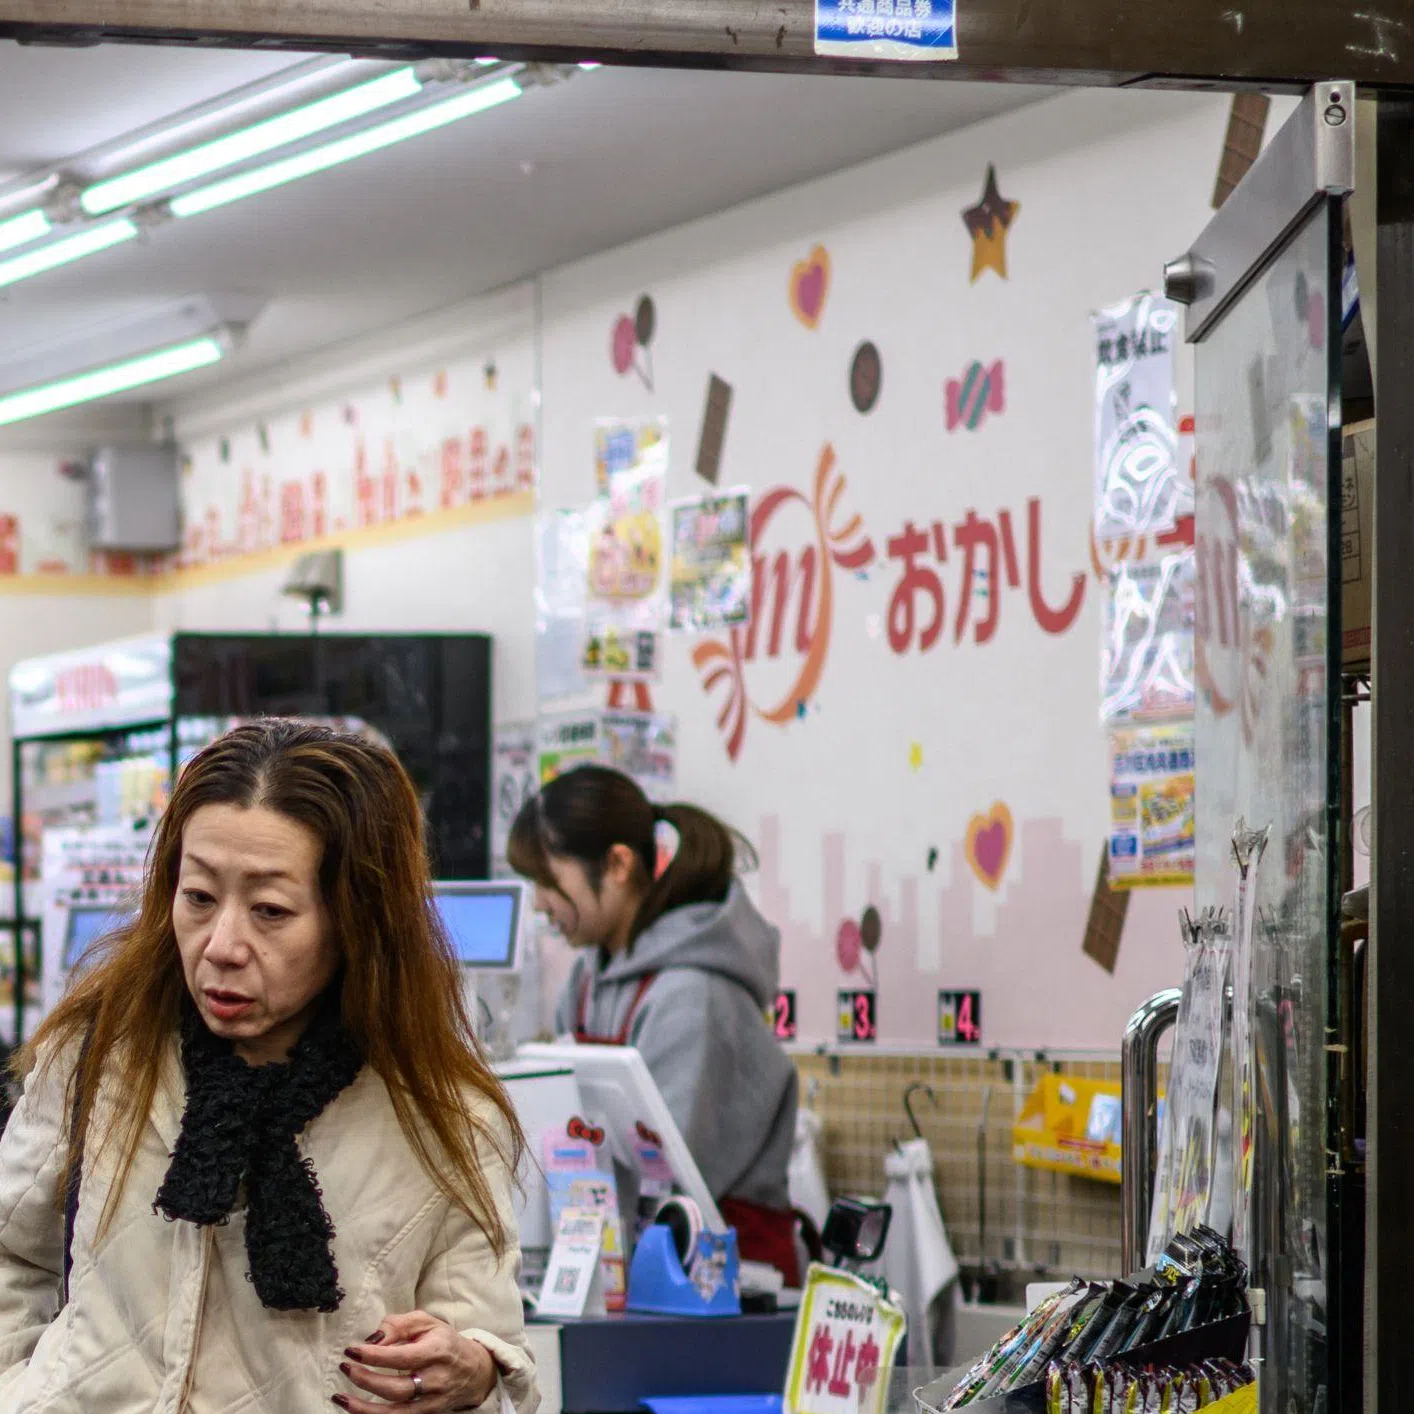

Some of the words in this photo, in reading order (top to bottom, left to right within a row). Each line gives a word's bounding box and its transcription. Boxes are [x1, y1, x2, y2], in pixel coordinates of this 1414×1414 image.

[846, 15, 922, 38] 歓迎の店
[886, 496, 1087, 655] おかし
[805, 1323, 880, 1405] 休止中
